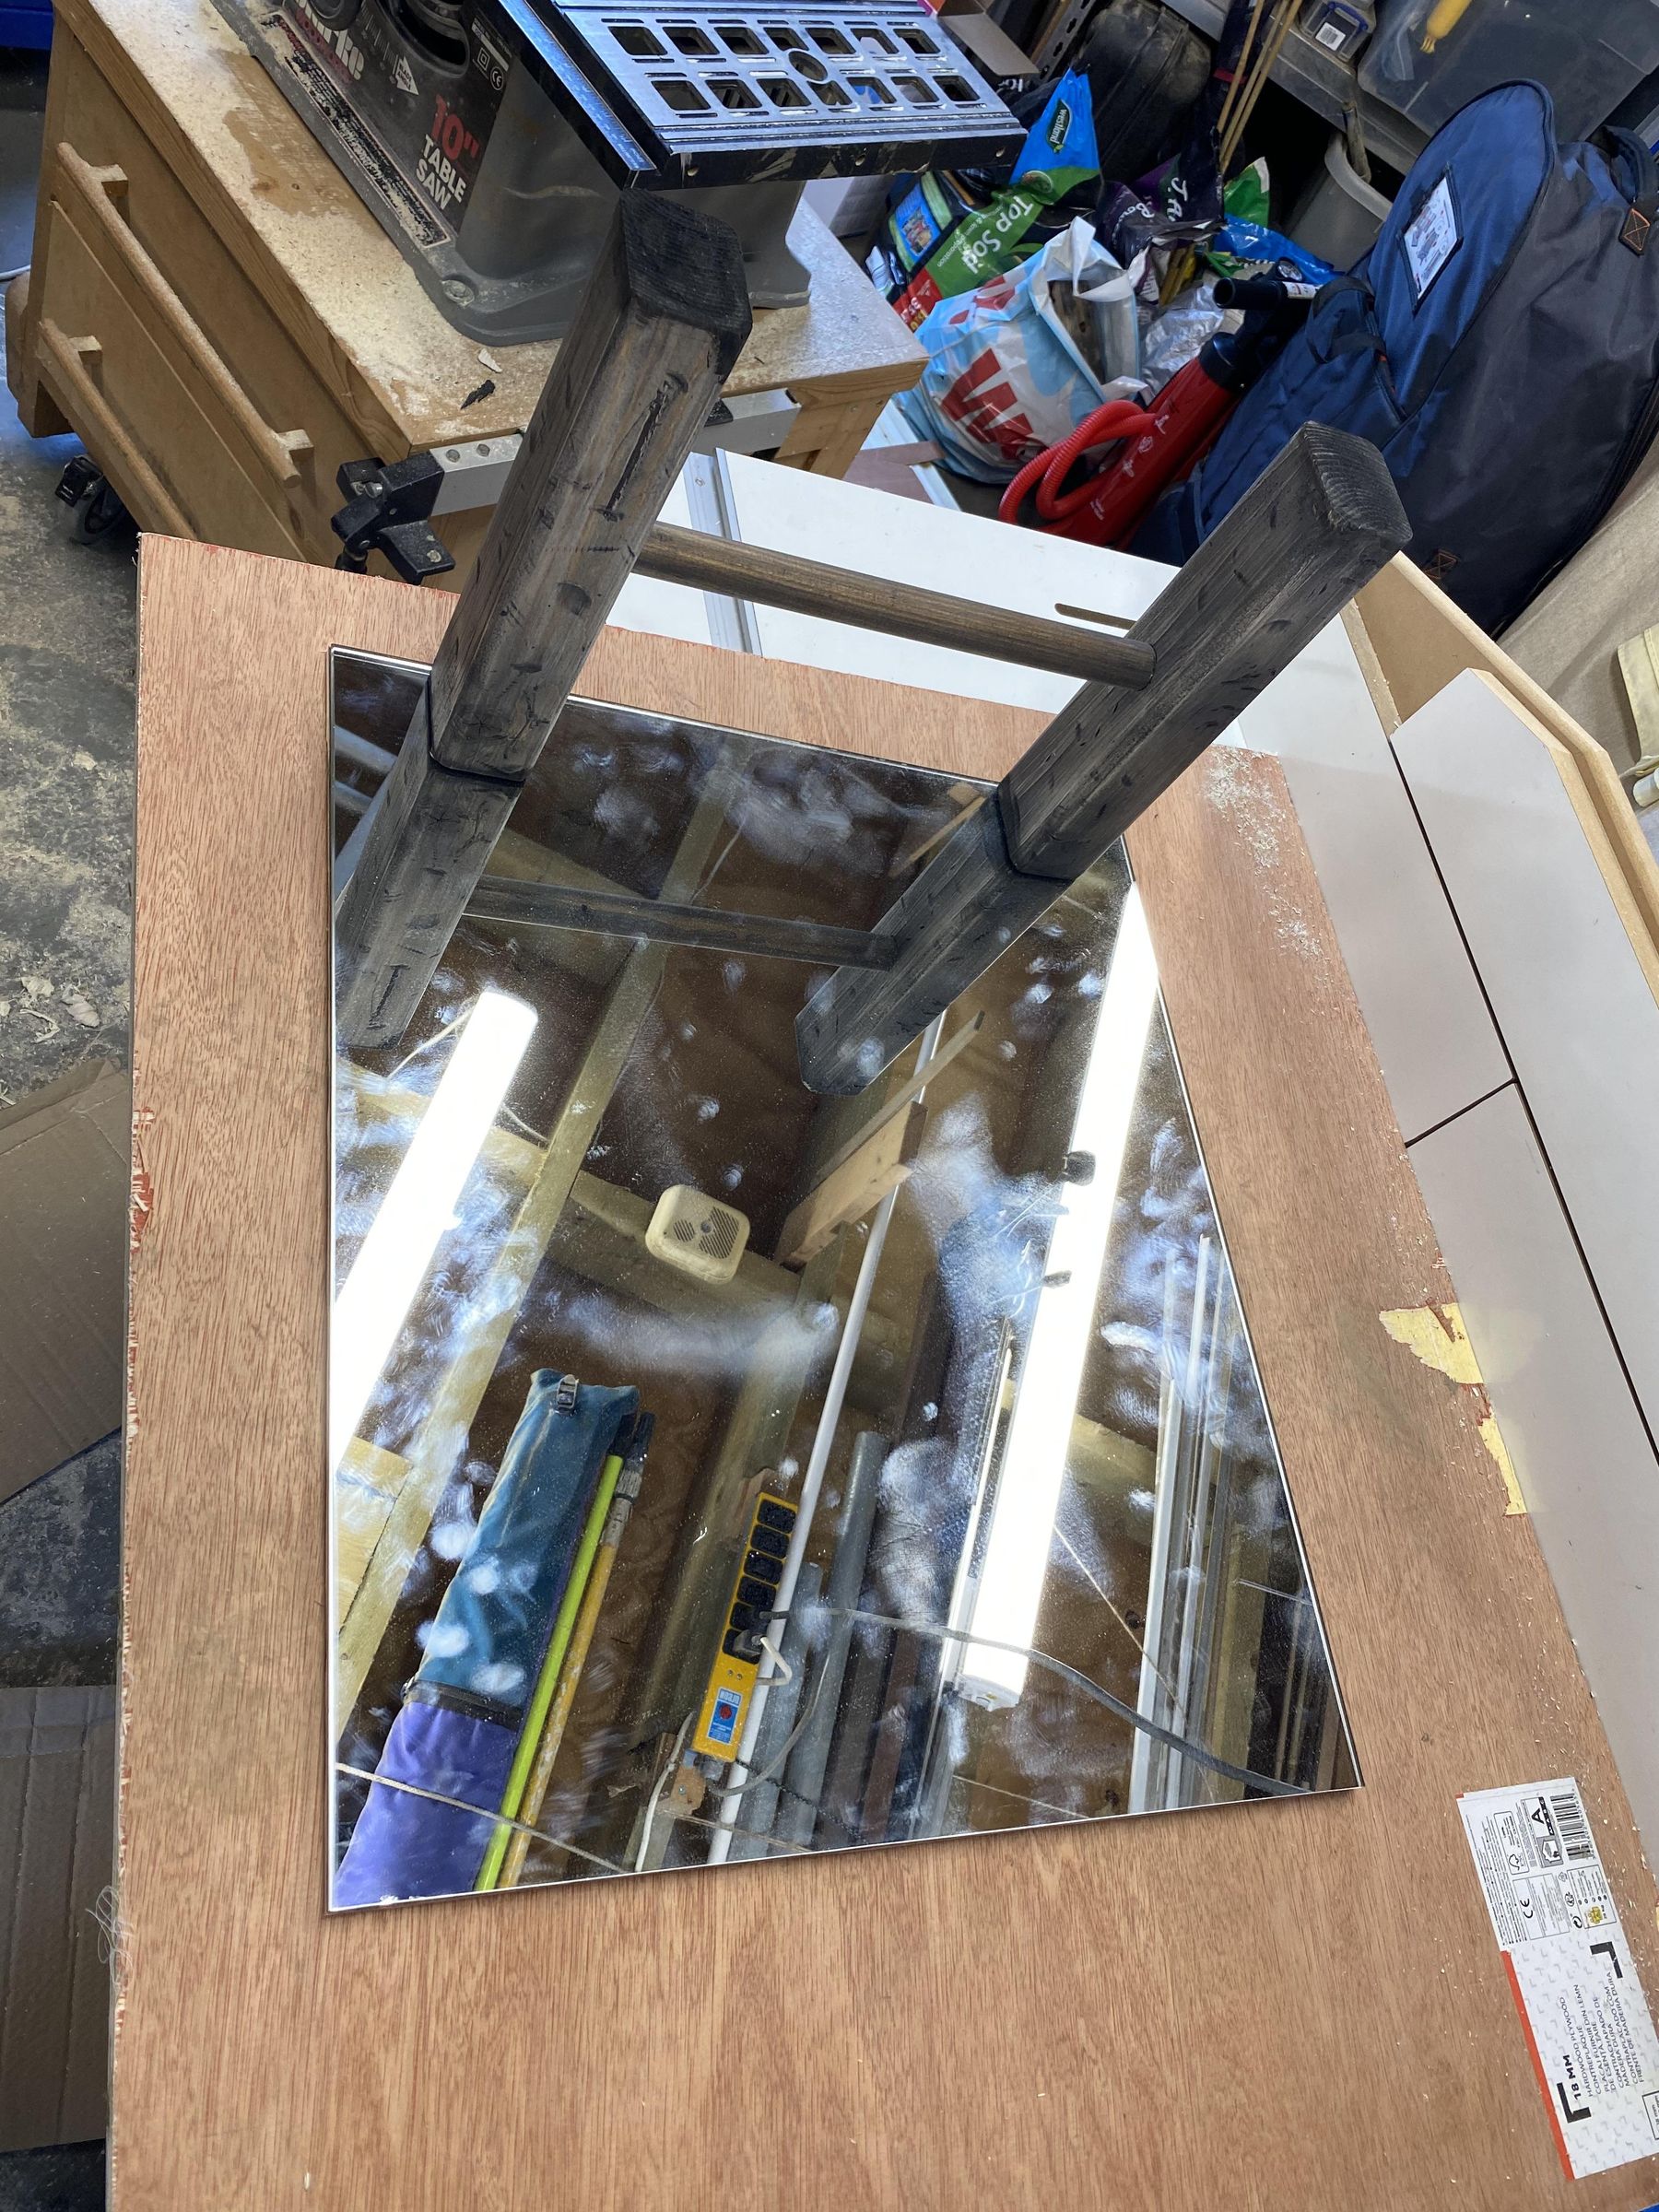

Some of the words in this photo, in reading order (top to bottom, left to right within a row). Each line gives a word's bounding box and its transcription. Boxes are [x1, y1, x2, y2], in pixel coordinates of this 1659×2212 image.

[431, 93, 479, 160] 10"
[416, 159, 452, 210] SAW
[423, 134, 466, 204] TABLE
[994, 194, 1033, 234] Top
[935, 233, 966, 267] preparation
[1531, 1808, 1544, 1824] A
[1573, 1984, 1584, 2008] LEMN
[1605, 1986, 1615, 2006] COM
[1606, 1972, 1618, 1995] DURA
[1593, 1996, 1600, 2008] DE
[1614, 1997, 1630, 2036] MADEIRA
[1559, 1996, 1577, 2041] PLYWOOD
[1582, 2010, 1590, 2026] DIN
[1591, 2021, 1601, 2041] TARE
[1586, 2027, 1600, 2058] FURNIR
[1596, 2010, 1625, 2088] CONTRACHAPADO
[1607, 2023, 1618, 2048] DURA
[1611, 2008, 1639, 2084] CONTRAPLACADO
[1627, 2038, 1634, 2050] DE
[1562, 2054, 1575, 2078] MM
[1573, 2042, 1594, 2097] HARDWOOD
[1615, 2050, 1630, 2087] MADERA
[1630, 2051, 1644, 2082] FRENTE
[1571, 2083, 1582, 2099] 18
[1608, 2078, 1617, 2090] DE
